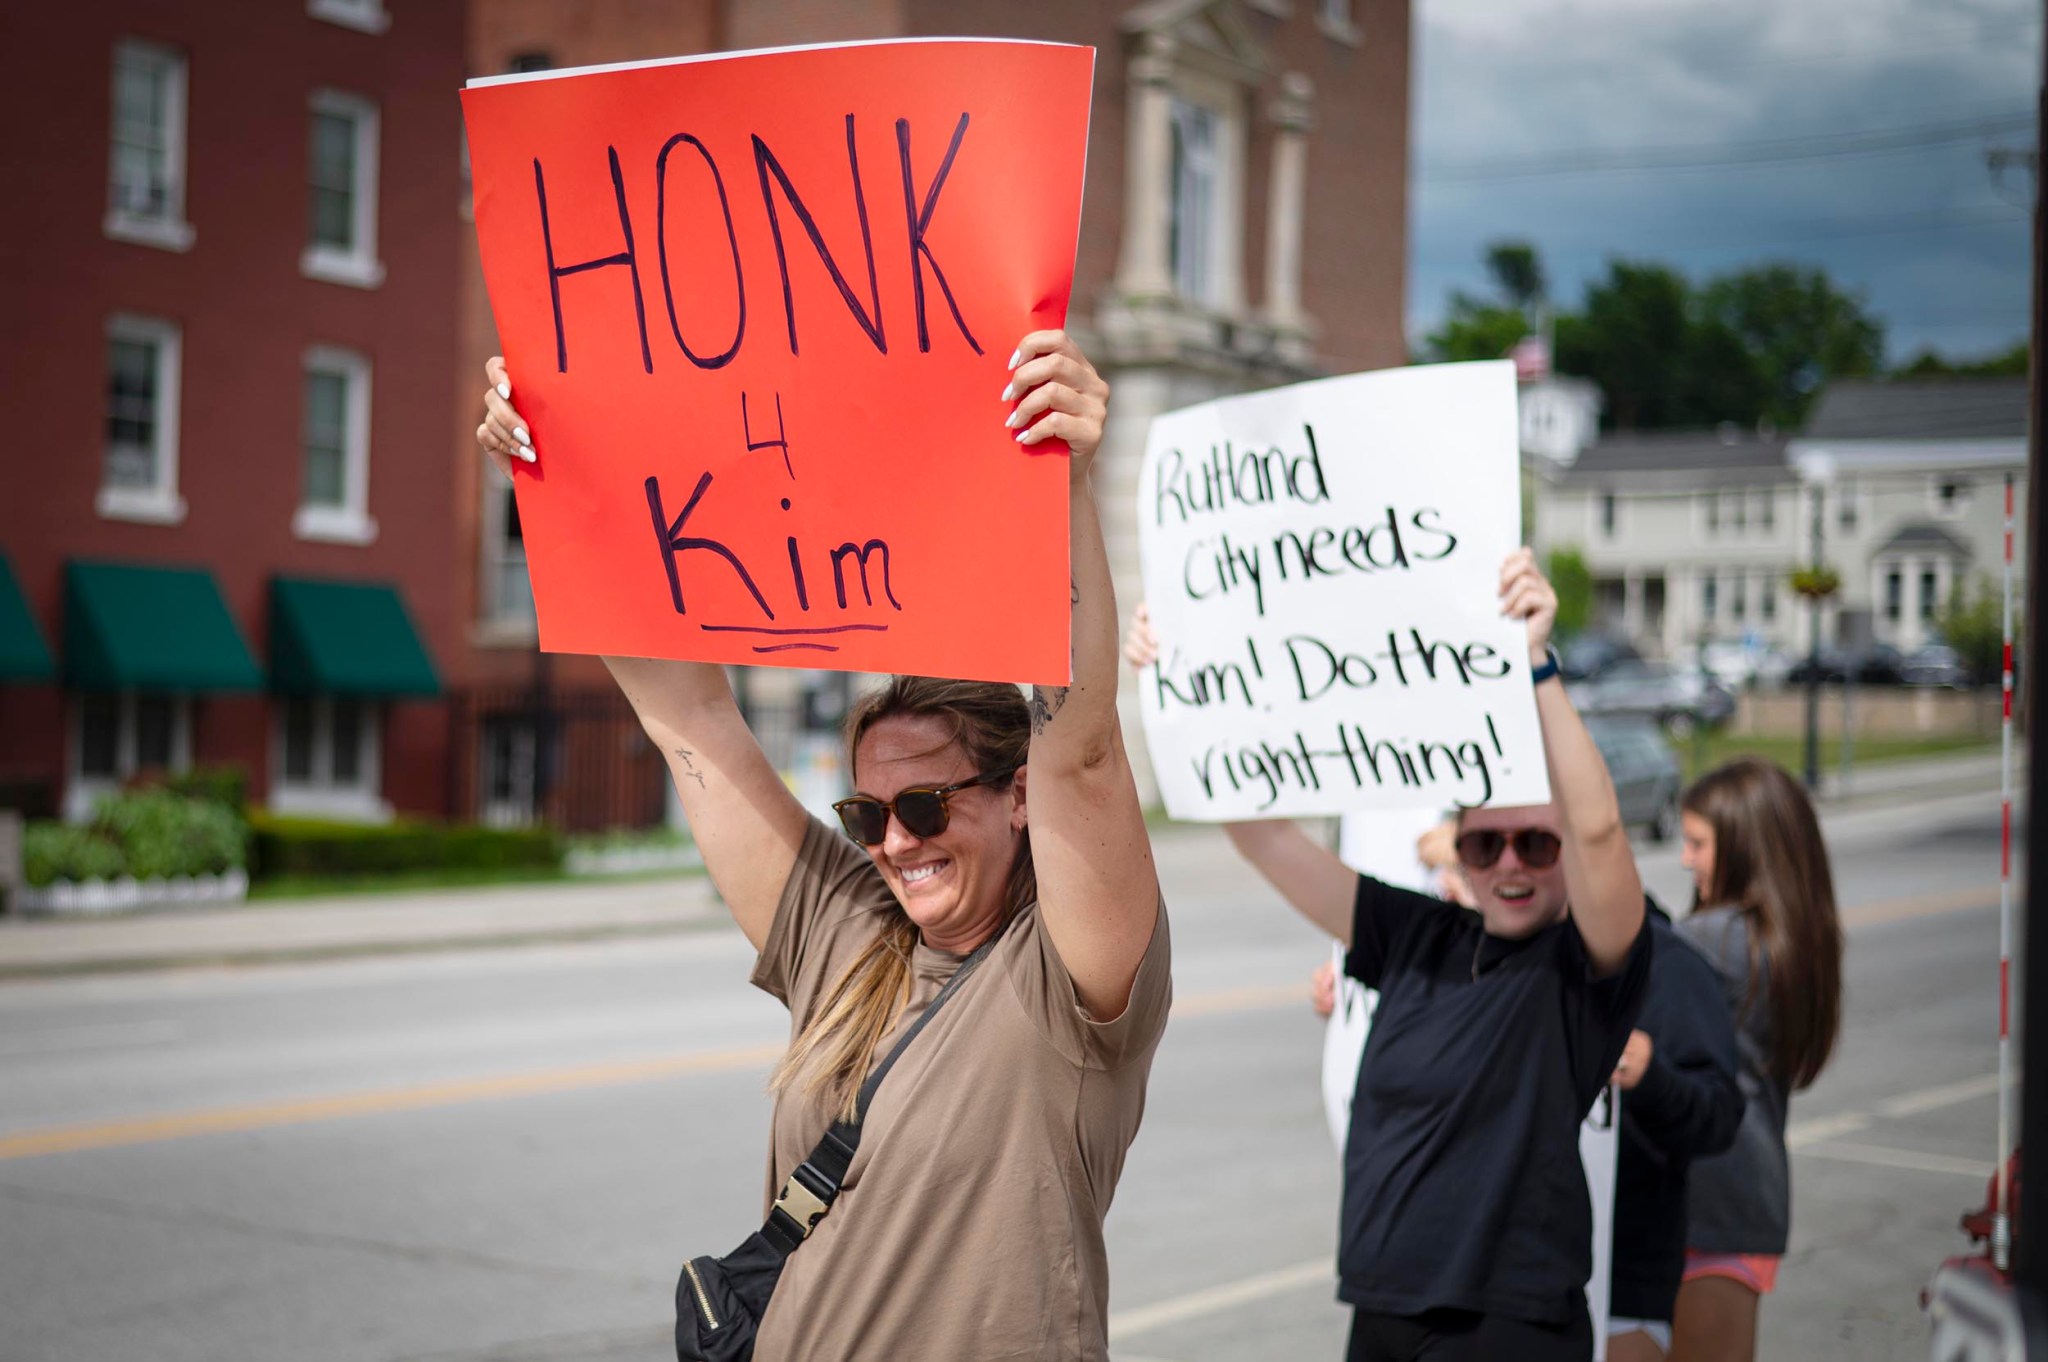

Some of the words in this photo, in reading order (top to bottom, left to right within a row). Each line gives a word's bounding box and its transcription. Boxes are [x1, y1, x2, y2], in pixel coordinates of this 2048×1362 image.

[533, 111, 985, 374] HONK
[742, 391, 796, 481] 4
[1156, 423, 1331, 526] Rutland
[645, 471, 902, 621] Kim
[1183, 533, 1266, 616] City
[1273, 506, 1458, 582] needs
[1155, 636, 1272, 710] Kim!
[1281, 634, 1378, 701] Do
[1376, 627, 1512, 686] the
[1192, 731, 1321, 812] right
[1318, 711, 1513, 809] thing!
